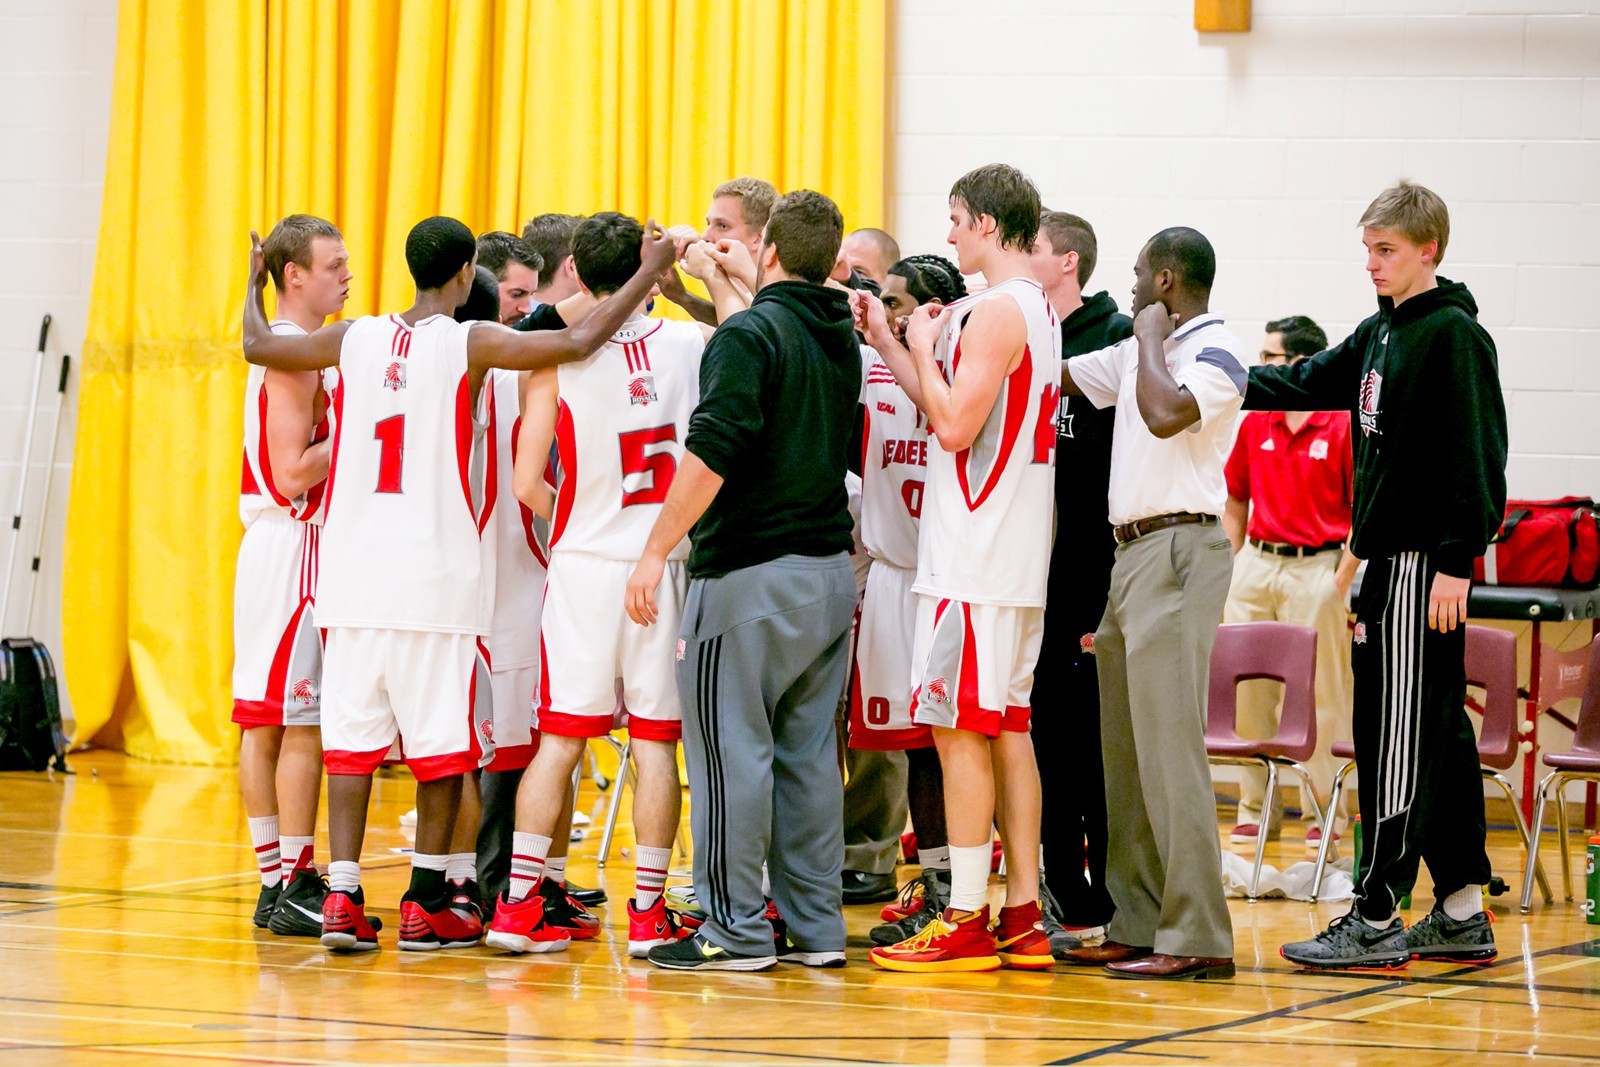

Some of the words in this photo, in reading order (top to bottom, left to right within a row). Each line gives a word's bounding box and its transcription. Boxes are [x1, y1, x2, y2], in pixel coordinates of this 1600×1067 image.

[374, 414, 405, 494] 1
[618, 423, 678, 509] 5
[882, 440, 928, 469] EDEE
